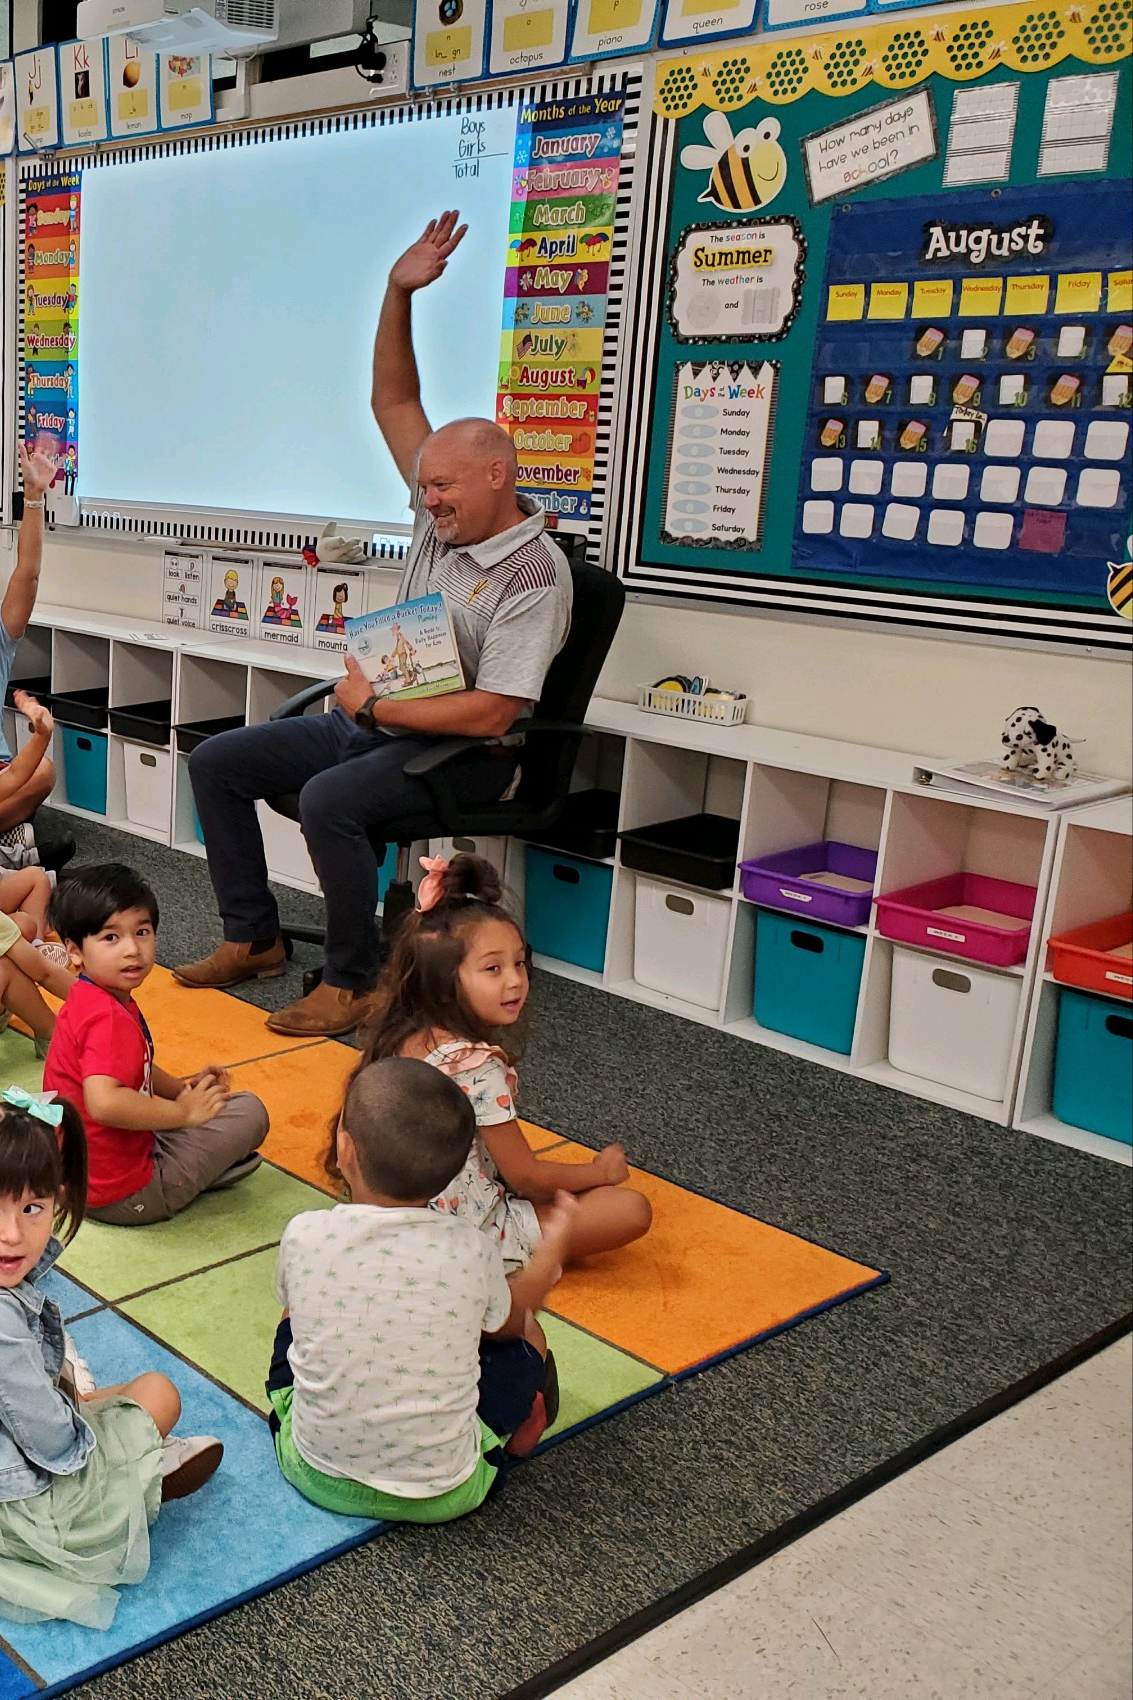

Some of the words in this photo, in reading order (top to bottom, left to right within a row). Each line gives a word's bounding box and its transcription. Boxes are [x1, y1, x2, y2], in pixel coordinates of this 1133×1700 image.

[804, 1, 830, 12] rose
[692, 17, 724, 34] queen
[597, 34, 623, 50] piano
[73, 45, 90, 70] Kk
[509, 51, 544, 66] octopus
[28, 54, 43, 90] Jj
[438, 63, 456, 77] nest
[520, 103, 565, 124] Months
[568, 106, 577, 116] of
[578, 104, 592, 115] the
[594, 98, 623, 113] Year
[460, 116, 486, 139] Boys
[819, 135, 846, 153] How
[850, 120, 882, 142] many
[886, 106, 914, 126] days
[458, 138, 486, 158] Girls
[533, 133, 602, 158] January
[819, 154, 847, 172] have
[851, 145, 869, 159] we
[873, 131, 905, 150] been
[908, 124, 920, 136] in
[452, 159, 480, 180] Total
[28, 180, 45, 192] Days
[61, 174, 80, 187] Week
[526, 168, 602, 192] February
[533, 201, 586, 226] March
[710, 234, 724, 243] The
[726, 231, 758, 242] season
[759, 231, 766, 239] is
[925, 220, 1045, 264] August
[536, 233, 577, 262] April
[694, 246, 773, 268] Summer
[34, 249, 71, 267] Monday
[534, 267, 573, 293] May
[702, 278, 716, 287] The
[717, 275, 755, 286] weather
[756, 275, 764, 283] is
[835, 291, 858, 299] Sunday
[876, 289, 902, 298] Monday
[920, 287, 947, 296] Tuesday
[962, 284, 1002, 293] Wednesday
[1011, 281, 1045, 292] Thursday
[1067, 280, 1092, 289] Friday
[34, 293, 67, 308] Tuesday
[725, 301, 739, 309] and
[530, 302, 571, 323] June
[26, 334, 77, 352] Wednesday
[530, 331, 568, 360] July
[1027, 345, 1036, 361] 3
[30, 372, 70, 391] Thursday
[518, 363, 576, 390] August
[683, 385, 716, 402] Days
[728, 383, 766, 400] Week
[840, 392, 848, 406] 6
[885, 389, 893, 404] 7
[1014, 391, 1028, 407] 10
[1071, 392, 1082, 408] 11
[503, 396, 587, 422] September
[722, 409, 750, 418] Sunday
[36, 412, 66, 432] Friday
[513, 429, 573, 452] October
[720, 428, 750, 438] Monday
[718, 447, 750, 458] Tuesday
[835, 435, 846, 449] 13
[917, 438, 928, 453] 15
[517, 463, 581, 485] ovember
[717, 466, 760, 477] Wednesday
[715, 486, 751, 497] Thursday
[712, 505, 736, 514] Friday
[711, 523, 746, 534] Saturday
[168, 569, 180, 578] look
[184, 572, 200, 581] listen
[166, 594, 180, 602] quiet
[181, 595, 198, 605] hands
[211, 621, 248, 635] crisscross
[264, 631, 299, 643] mermaid
